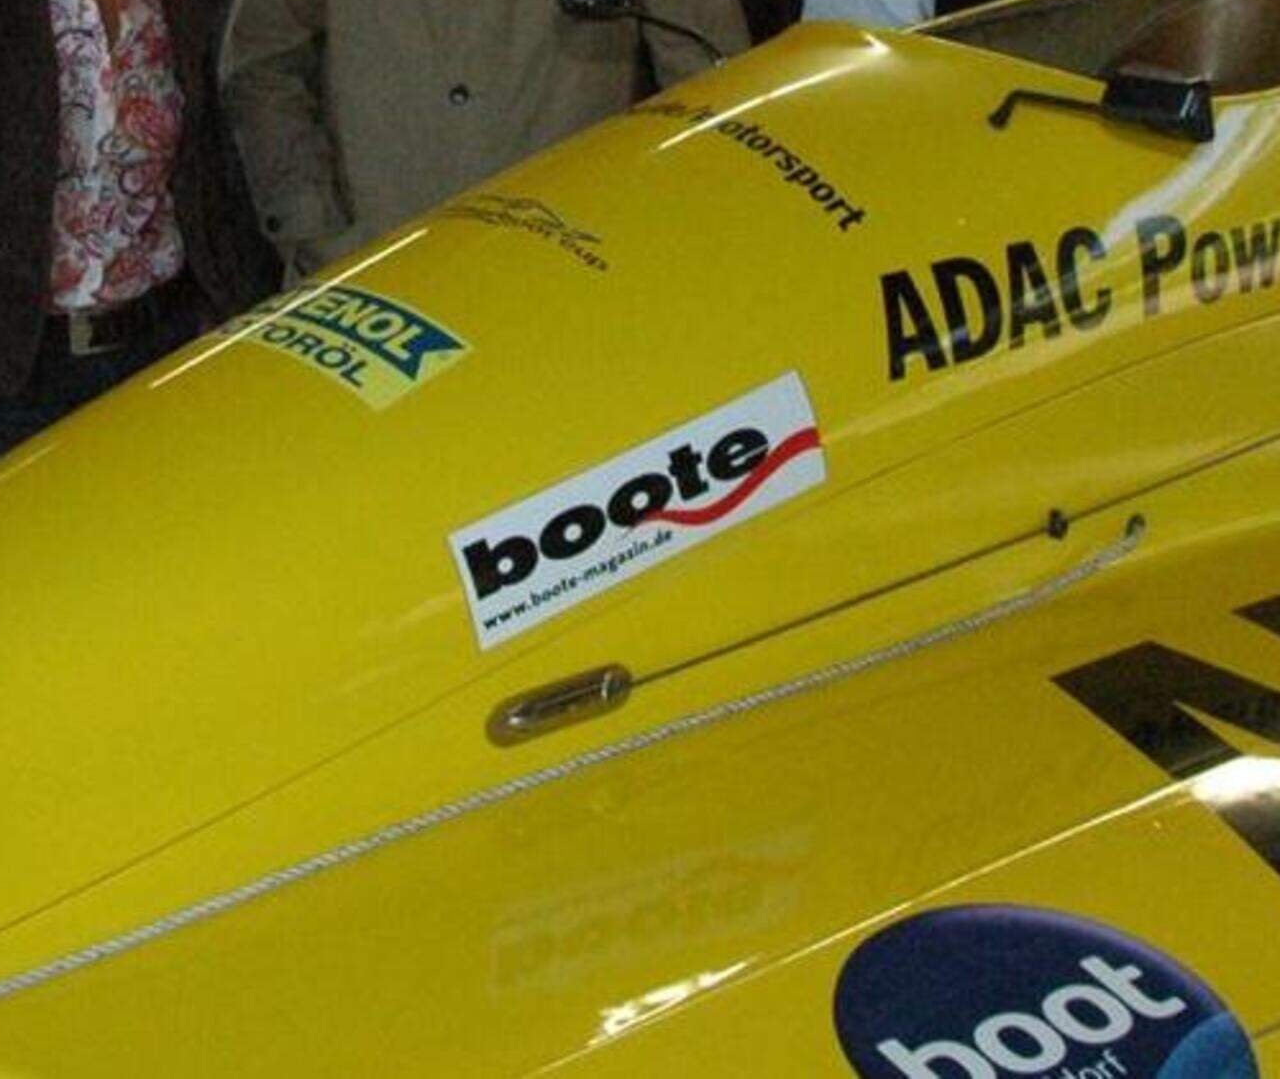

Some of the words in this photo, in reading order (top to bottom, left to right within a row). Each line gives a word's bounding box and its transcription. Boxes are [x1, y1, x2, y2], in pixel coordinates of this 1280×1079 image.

[265, 285, 421, 360] ENOL
[880, 226, 1112, 381] ADAC
[463, 428, 769, 600] boote
[483, 530, 673, 630] www.boote-magazin.de
[877, 955, 1187, 1079] boot
